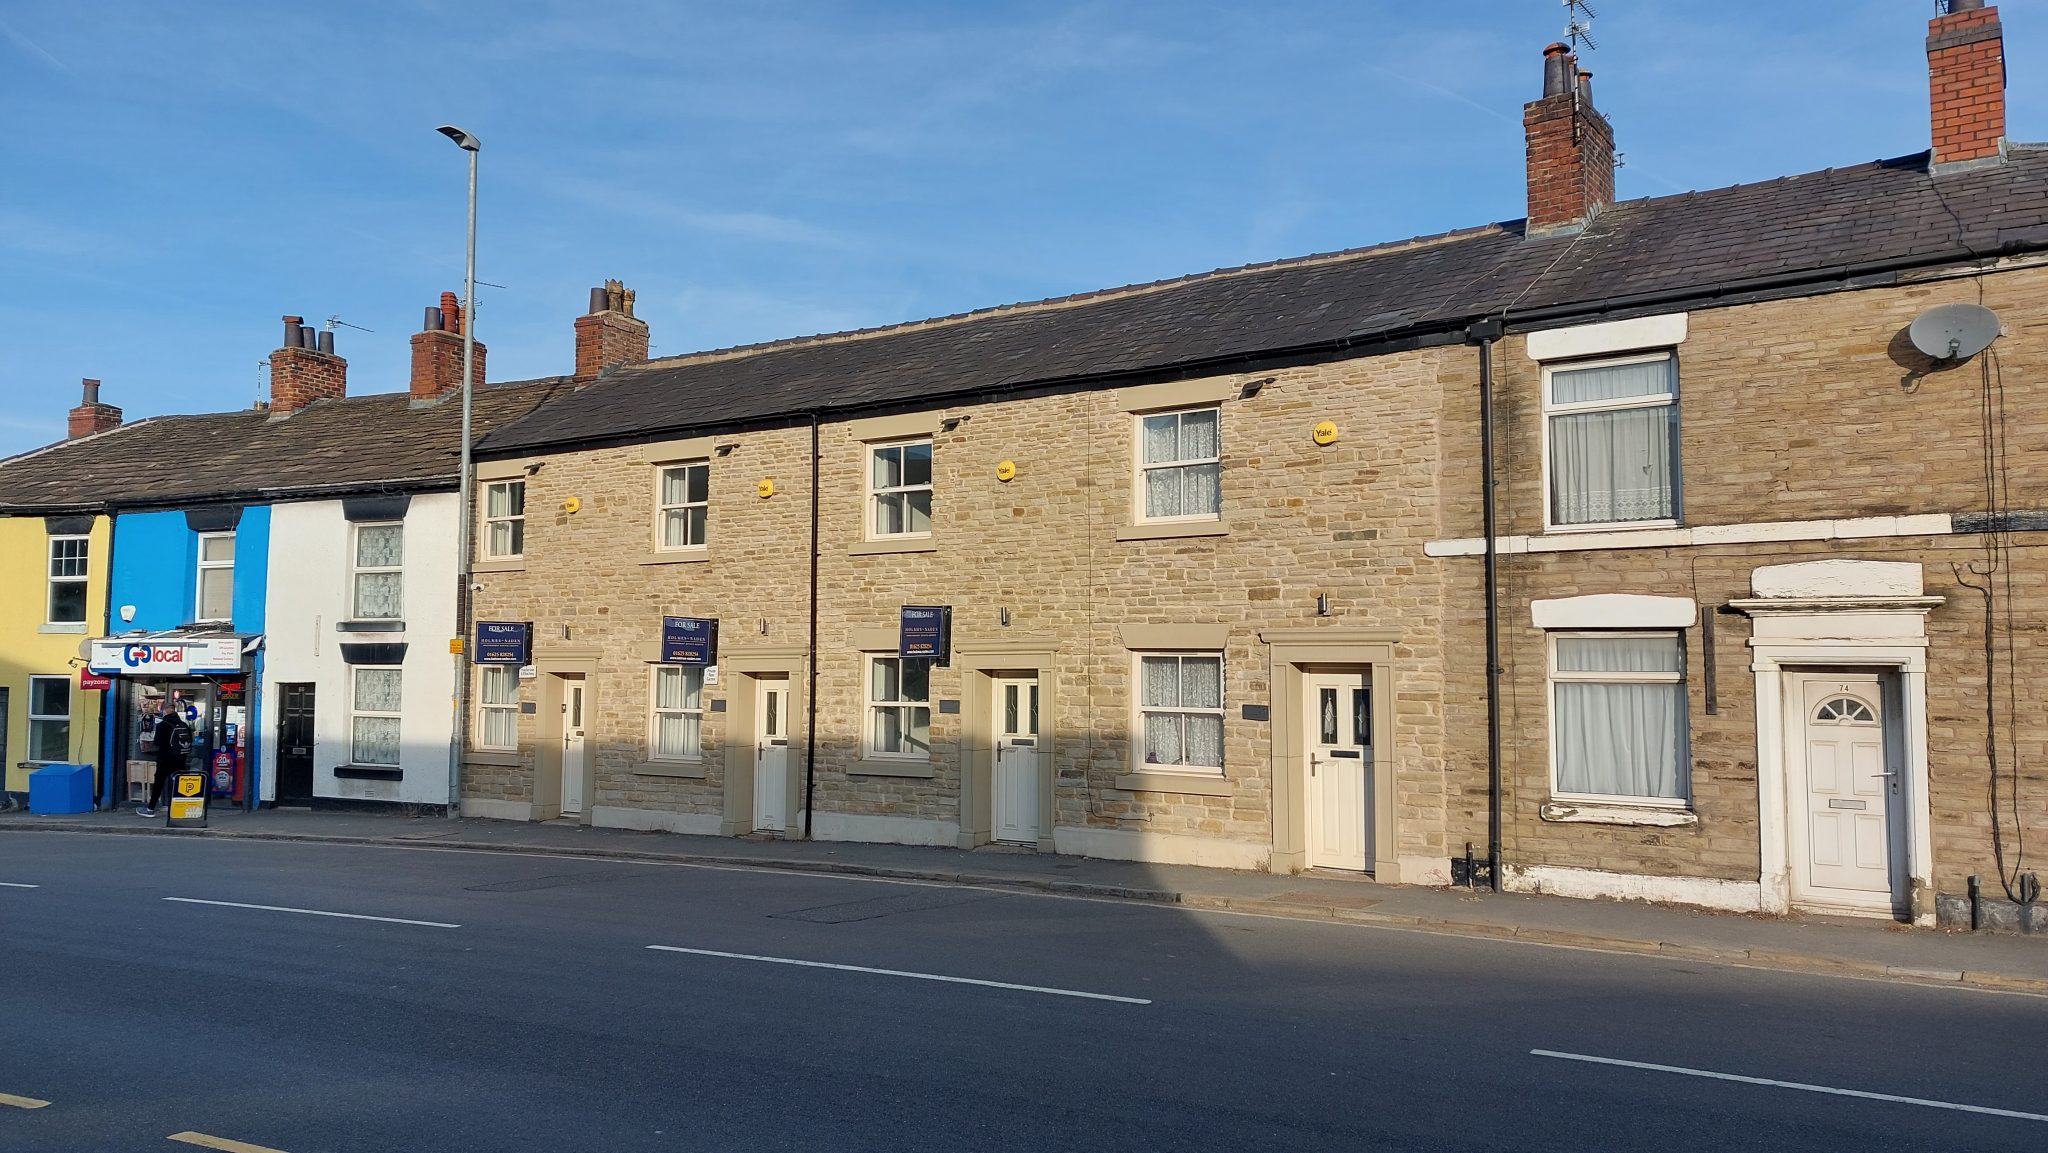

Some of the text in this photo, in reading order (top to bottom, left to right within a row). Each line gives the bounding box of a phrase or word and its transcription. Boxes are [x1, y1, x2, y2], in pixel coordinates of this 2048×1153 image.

[1316, 429, 1331, 437] Yale
[152, 646, 183, 663] local
[1839, 684, 1849, 692] 74
